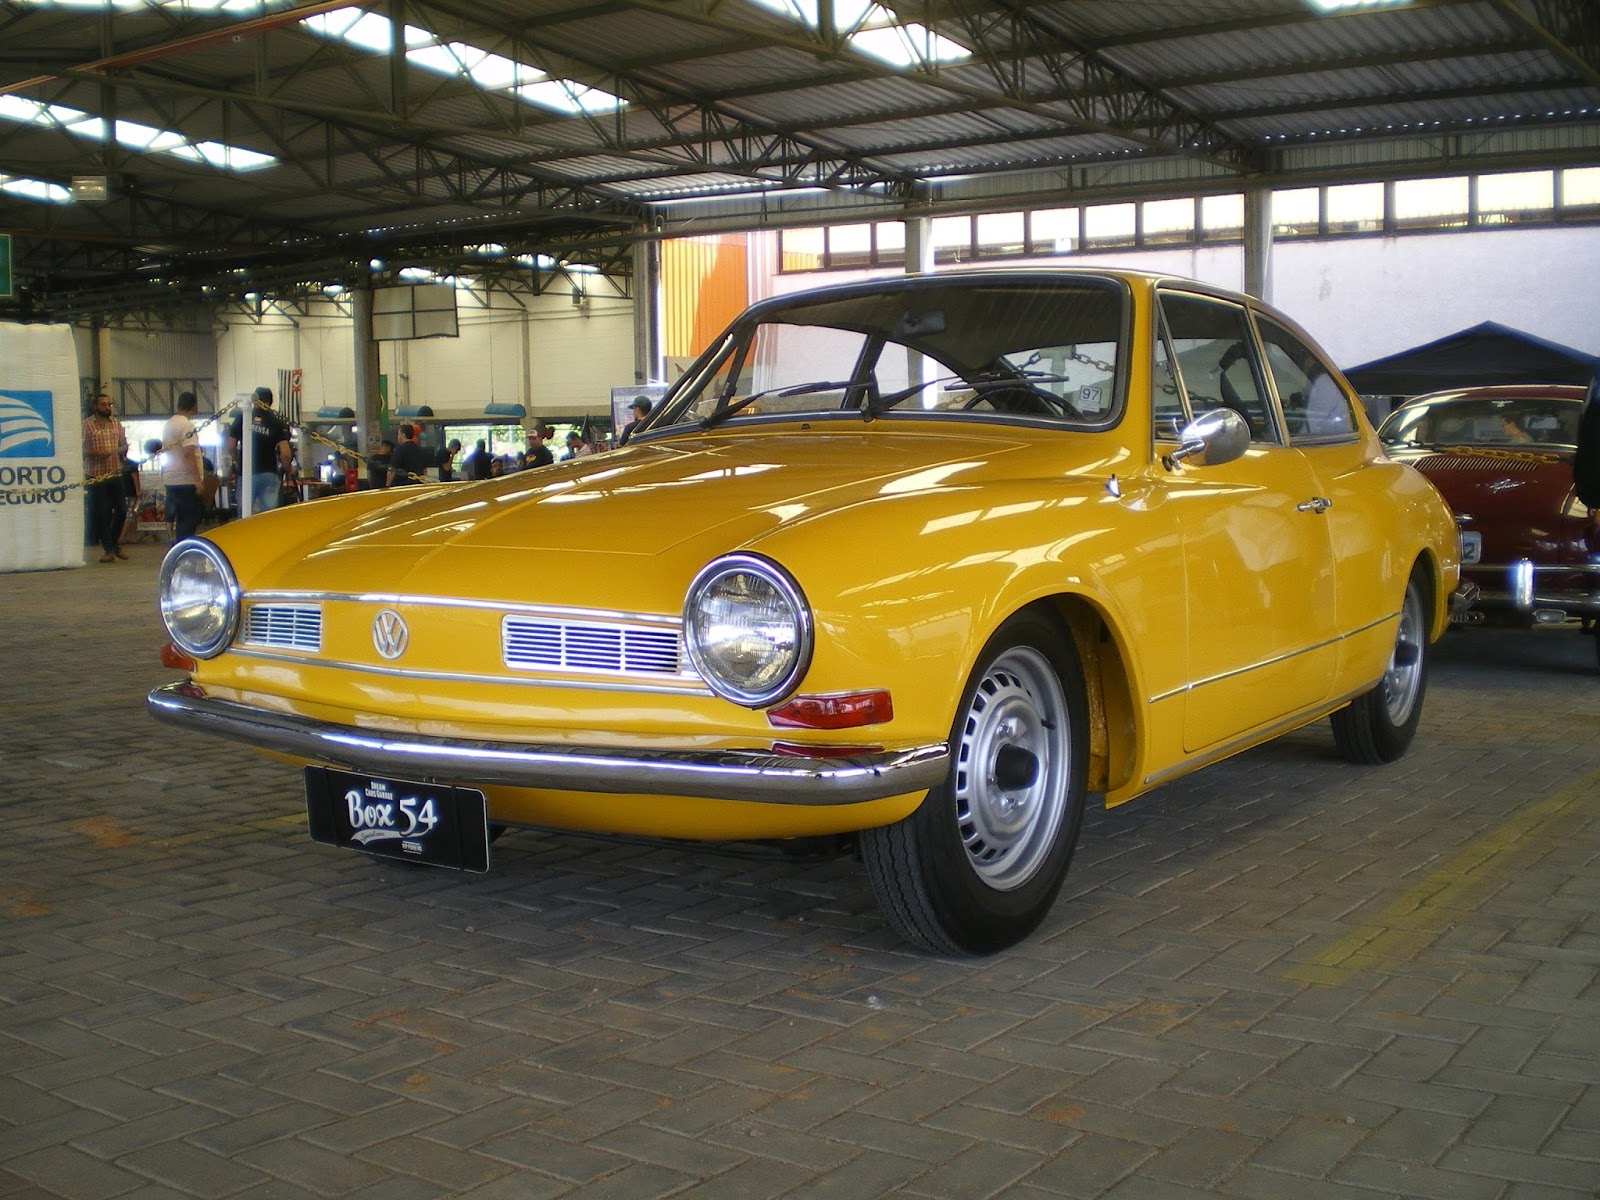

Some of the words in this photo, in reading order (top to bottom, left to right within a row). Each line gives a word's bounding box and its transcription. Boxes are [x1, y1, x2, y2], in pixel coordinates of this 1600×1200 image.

[1082, 388, 1099, 400] 97
[345, 790, 394, 828] Box
[400, 797, 437, 835] 54
